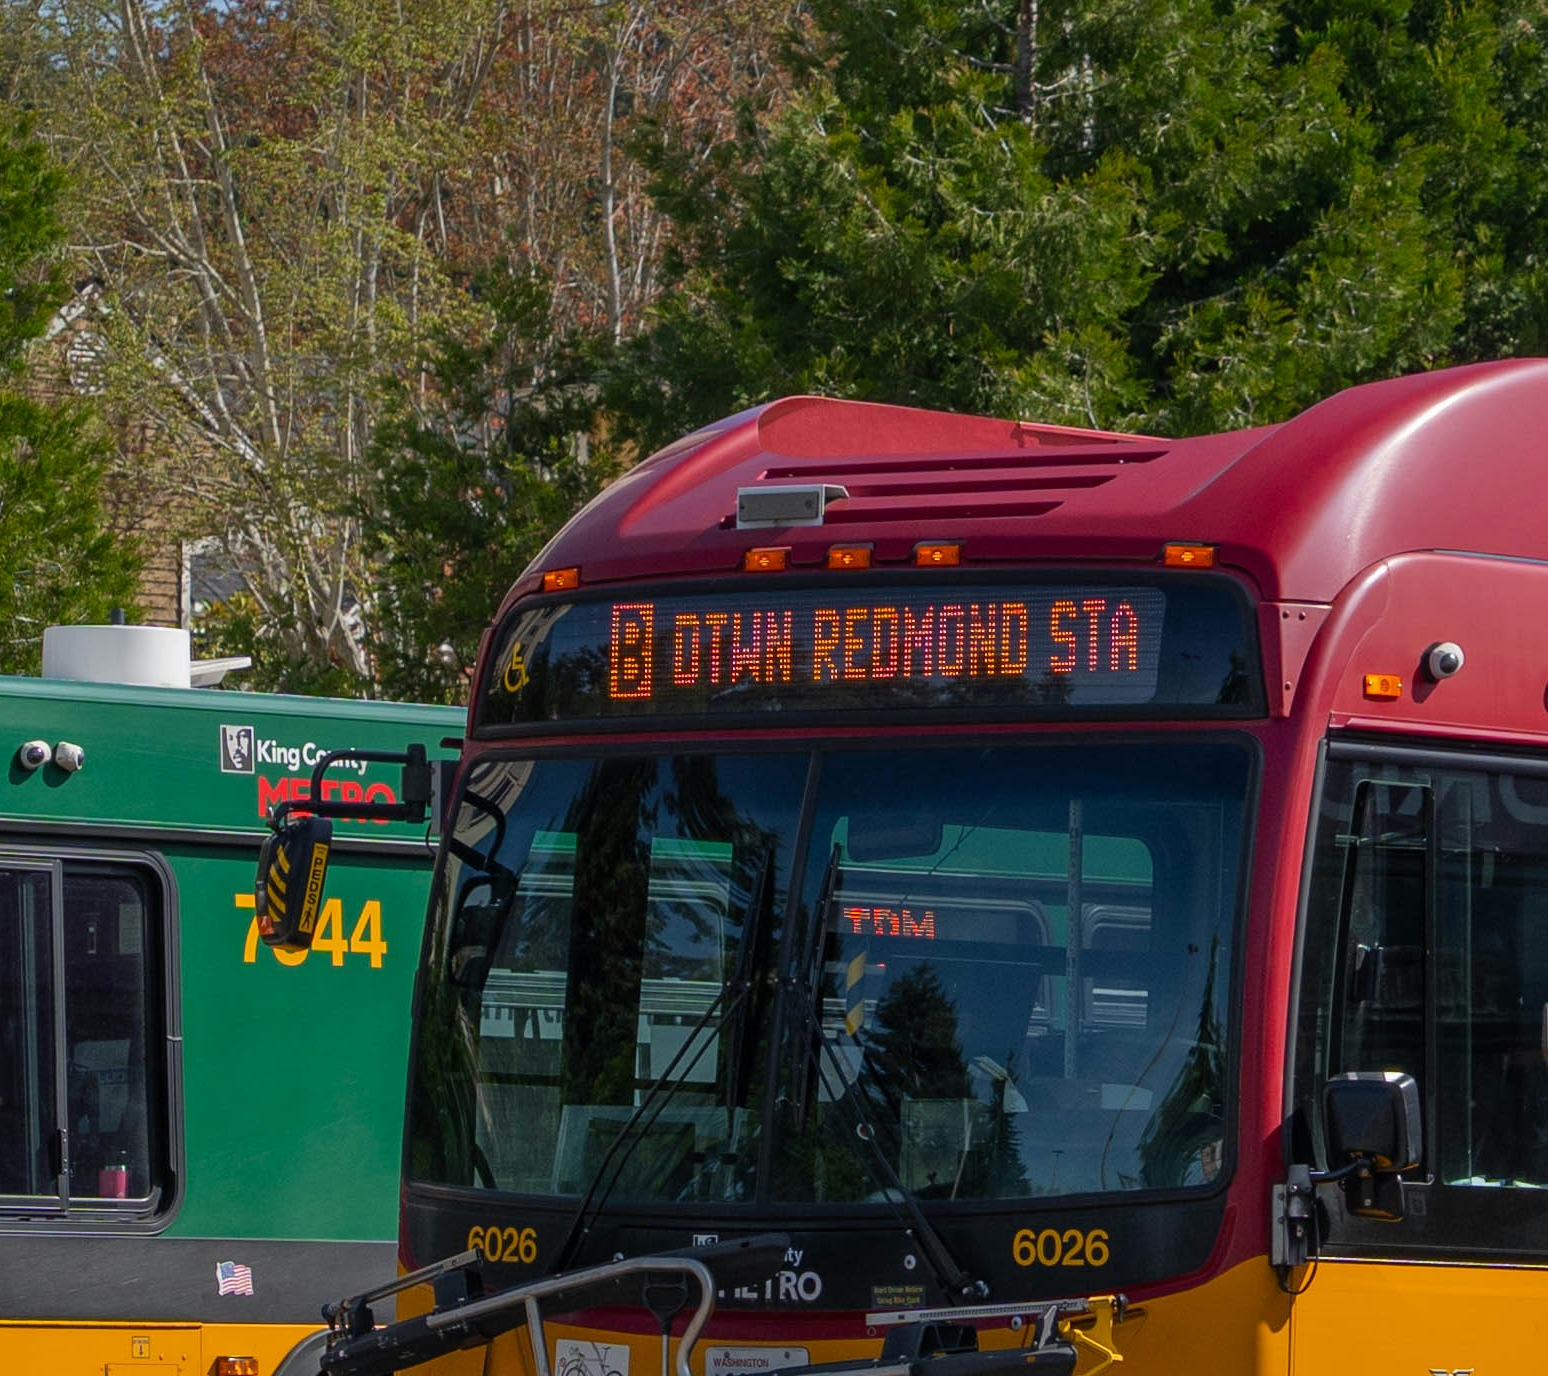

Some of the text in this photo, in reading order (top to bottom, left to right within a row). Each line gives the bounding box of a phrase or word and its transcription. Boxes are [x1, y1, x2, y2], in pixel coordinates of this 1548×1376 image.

[812, 602, 1028, 681] REDMOND
[1049, 598, 1139, 674] STA
[256, 739, 300, 771] King
[234, 893, 388, 969] 744
[468, 1225, 538, 1264] 6026
[1012, 1228, 1110, 1267] 6026
[713, 1358, 770, 1368] WASHINGTON
